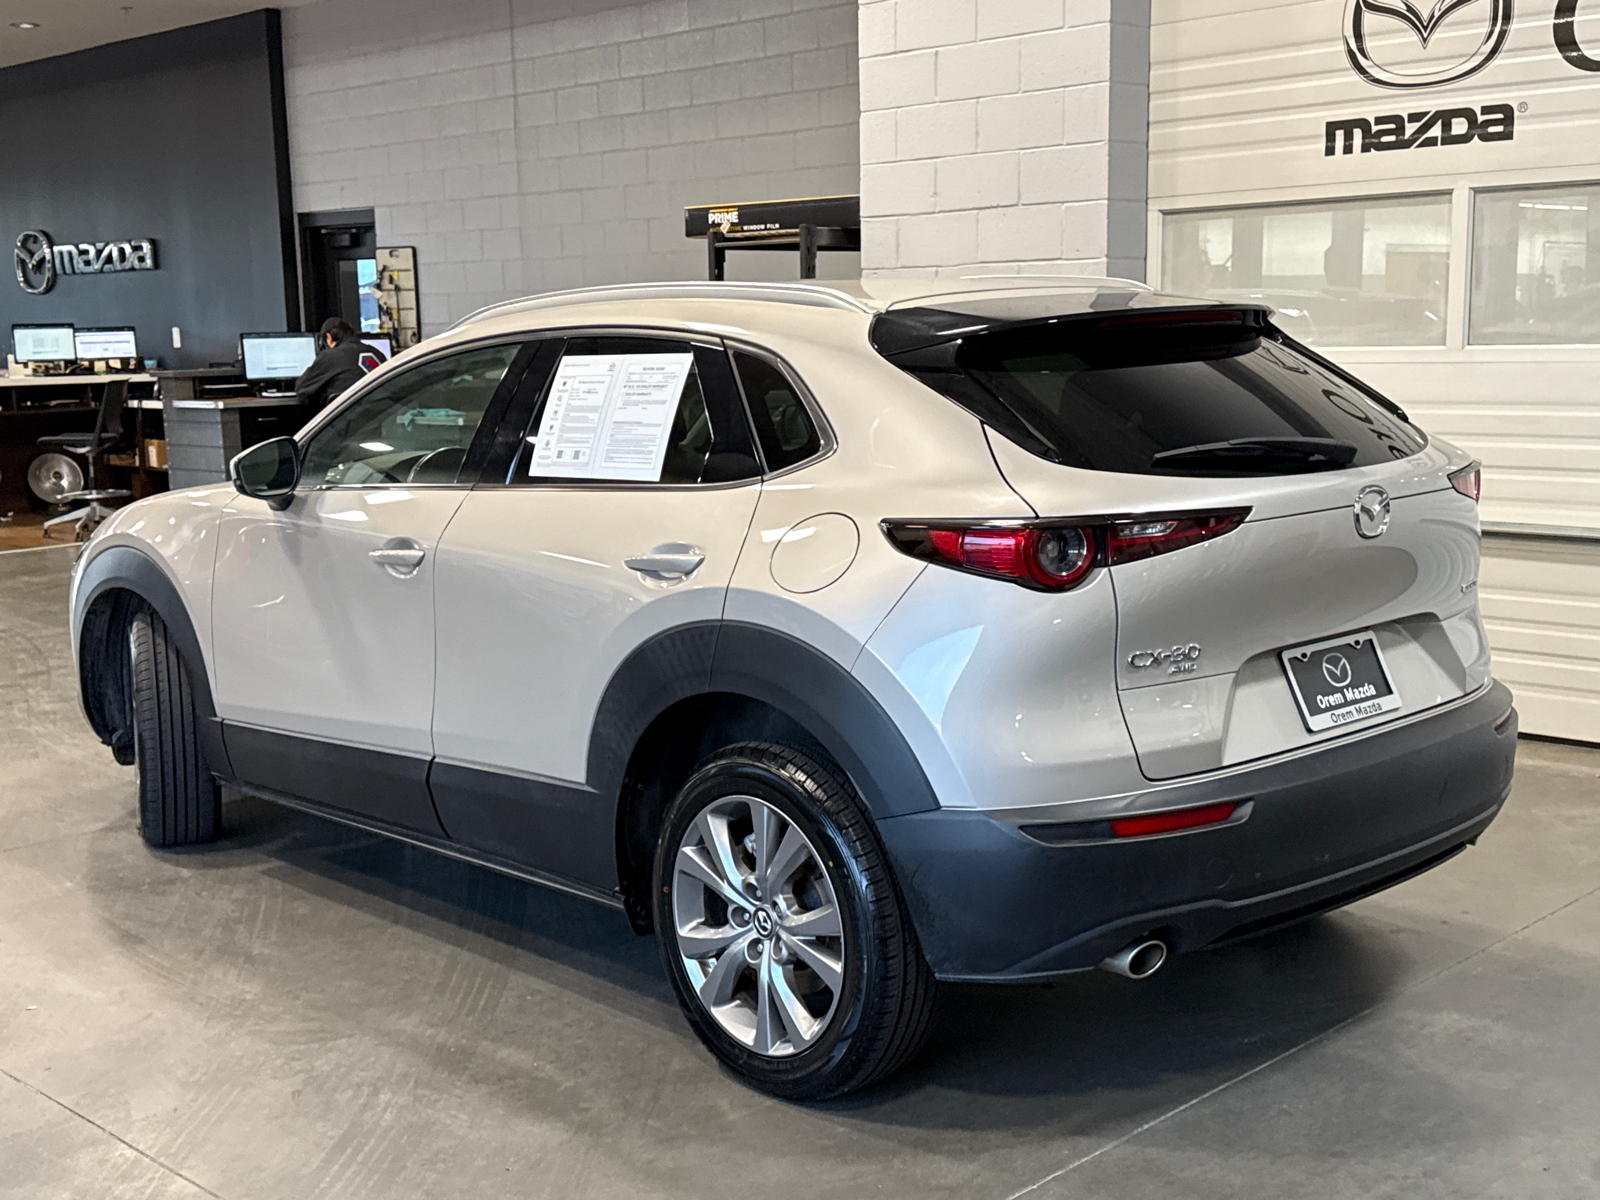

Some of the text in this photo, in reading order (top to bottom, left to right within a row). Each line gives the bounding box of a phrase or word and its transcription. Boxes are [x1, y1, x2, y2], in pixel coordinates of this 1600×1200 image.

[708, 211, 739, 224] PRIME
[1316, 682, 1377, 709] Orem Mazda
[1330, 701, 1383, 724] Orem Mazda
